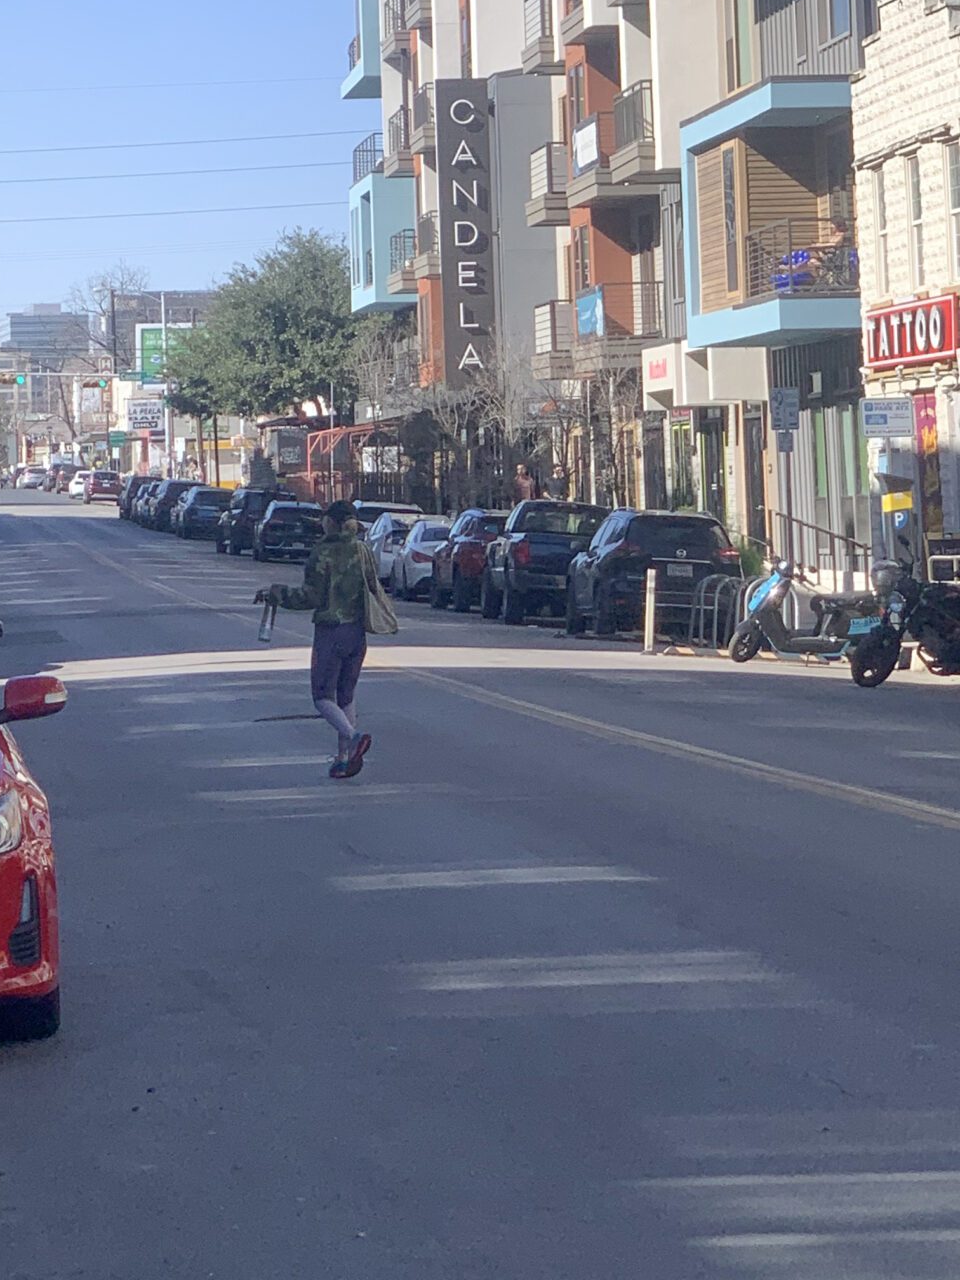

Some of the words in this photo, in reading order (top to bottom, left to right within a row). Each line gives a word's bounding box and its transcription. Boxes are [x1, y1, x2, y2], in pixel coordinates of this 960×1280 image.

[449, 99, 484, 370] CANDELA
[866, 305, 942, 358] TATTOO
[894, 512, 904, 528] P
